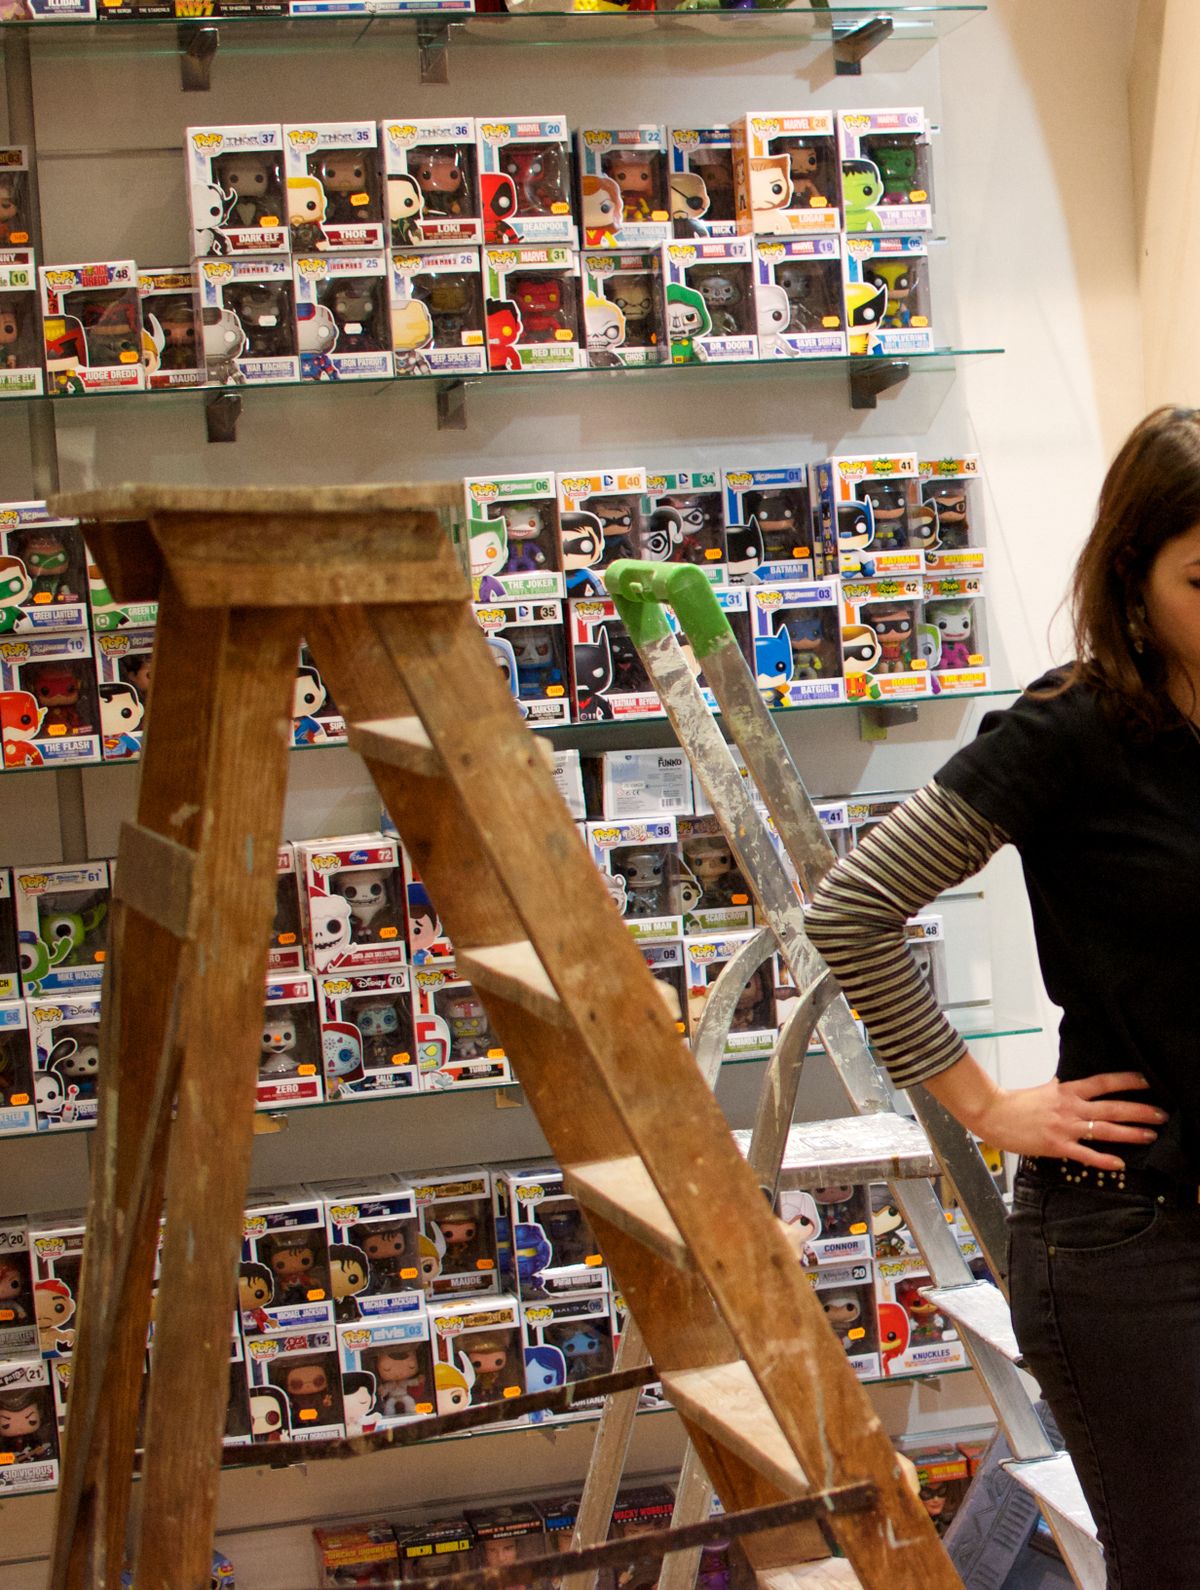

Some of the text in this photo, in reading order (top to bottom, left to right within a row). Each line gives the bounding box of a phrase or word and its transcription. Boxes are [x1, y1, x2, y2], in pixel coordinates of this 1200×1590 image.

[517, 123, 540, 133] MARVEL
[783, 119, 810, 129] MARVEL
[388, 126, 417, 140] POP!
[455, 126, 467, 135] 36
[481, 124, 510, 138] POP!
[548, 125, 560, 134] 20
[192, 132, 223, 147] POP!
[262, 134, 275, 144] 37
[287, 129, 317, 146] POP!
[357, 132, 368, 141] 35
[648, 132, 659, 140] 22
[438, 224, 460, 233] LOKI
[523, 223, 565, 232] DEADPOOL
[239, 233, 279, 243] DARK ELF
[339, 230, 366, 239] THOR
[703, 245, 724, 253] MARVEL
[733, 245, 743, 255] 17
[792, 242, 814, 250] MARVEL
[822, 243, 832, 253] 19
[461, 256, 472, 264] 26
[487, 251, 515, 265] POP!
[521, 250, 547, 262] MARVEL
[554, 251, 565, 259] 31
[273, 263, 285, 273] 24
[297, 261, 327, 275] POP!
[366, 259, 377, 268] 25
[392, 256, 421, 270] POP!
[116, 270, 128, 279] 48
[202, 264, 232, 278] POP!
[14, 273, 26, 283] 10
[45, 271, 74, 286] POP!
[710, 341, 750, 350] DR. DOOM
[532, 349, 571, 357] RED HULK
[625, 353, 647, 361] GHOST
[246, 362, 291, 372] WAR MACHINE
[342, 359, 358, 367] IRON
[9, 374, 34, 384] THE ELF
[84, 369, 137, 380] JUDGE DREDD
[901, 461, 912, 469] 41
[966, 462, 976, 470] 43
[702, 475, 714, 485] 34
[789, 471, 799, 480] 01
[536, 481, 548, 491] 06
[563, 479, 591, 493] POP!
[628, 479, 639, 487] 40
[471, 484, 498, 498] POP!
[770, 565, 803, 574] BATMAN
[508, 579, 553, 589] THE JOKER
[906, 583, 917, 592] 42
[967, 582, 977, 590] 44
[819, 590, 830, 599] 03
[843, 585, 870, 599] POP!
[729, 595, 740, 604] 31
[128, 606, 147, 617] GREEN
[542, 607, 555, 617] 35
[577, 603, 604, 616] POP!
[33, 610, 79, 621] GREEN LANTERN
[477, 610, 504, 623] POP!
[70, 640, 81, 649] 10
[99, 637, 130, 653] POP!
[1, 643, 29, 659] POP!
[892, 678, 918, 686] ROBIN
[801, 685, 834, 694] BATGIRL
[44, 742, 90, 752] THE FLASH
[657, 756, 682, 769] FUNKO
[830, 813, 841, 821] 41
[593, 829, 620, 842] POP!
[658, 826, 670, 835] 38
[380, 851, 392, 861] 72
[312, 855, 340, 869] POP!
[88, 873, 99, 882] 61
[640, 922, 672, 931] TIN MAN
[926, 927, 937, 936] 48
[664, 950, 676, 959] 09
[357, 977, 386, 988] Disney
[390, 976, 402, 986] 70
[296, 985, 307, 995] 71
[323, 980, 352, 995] POP!
[6, 1012, 20, 1022] 58
[33, 1009, 62, 1024] POP!
[469, 1065, 491, 1074] TURBO
[376, 1074, 392, 1083] SALLY
[275, 1084, 298, 1093] ZERO
[473, 1183, 483, 1192] 84
[517, 1187, 544, 1200] POP!
[330, 1205, 359, 1220] POP!
[11, 1234, 23, 1245] 20
[824, 1242, 859, 1252] CONNOR
[854, 1268, 865, 1278] 20
[451, 1276, 482, 1287] MAUDE
[363, 1296, 418, 1309] MICHAEL JACKSON
[277, 1307, 327, 1320] MICHAEL JACKSON
[526, 1309, 553, 1322] POP!
[435, 1318, 464, 1331] POP!
[373, 1327, 405, 1340] elvis
[409, 1326, 421, 1335] 03
[317, 1336, 328, 1345] 12
[343, 1330, 372, 1344] POP!
[249, 1342, 278, 1355] POP!
[912, 1349, 950, 1360] KNUCKLES
[29, 1370, 40, 1379] 21
[3, 1465, 53, 1480] SID VICIOUS
